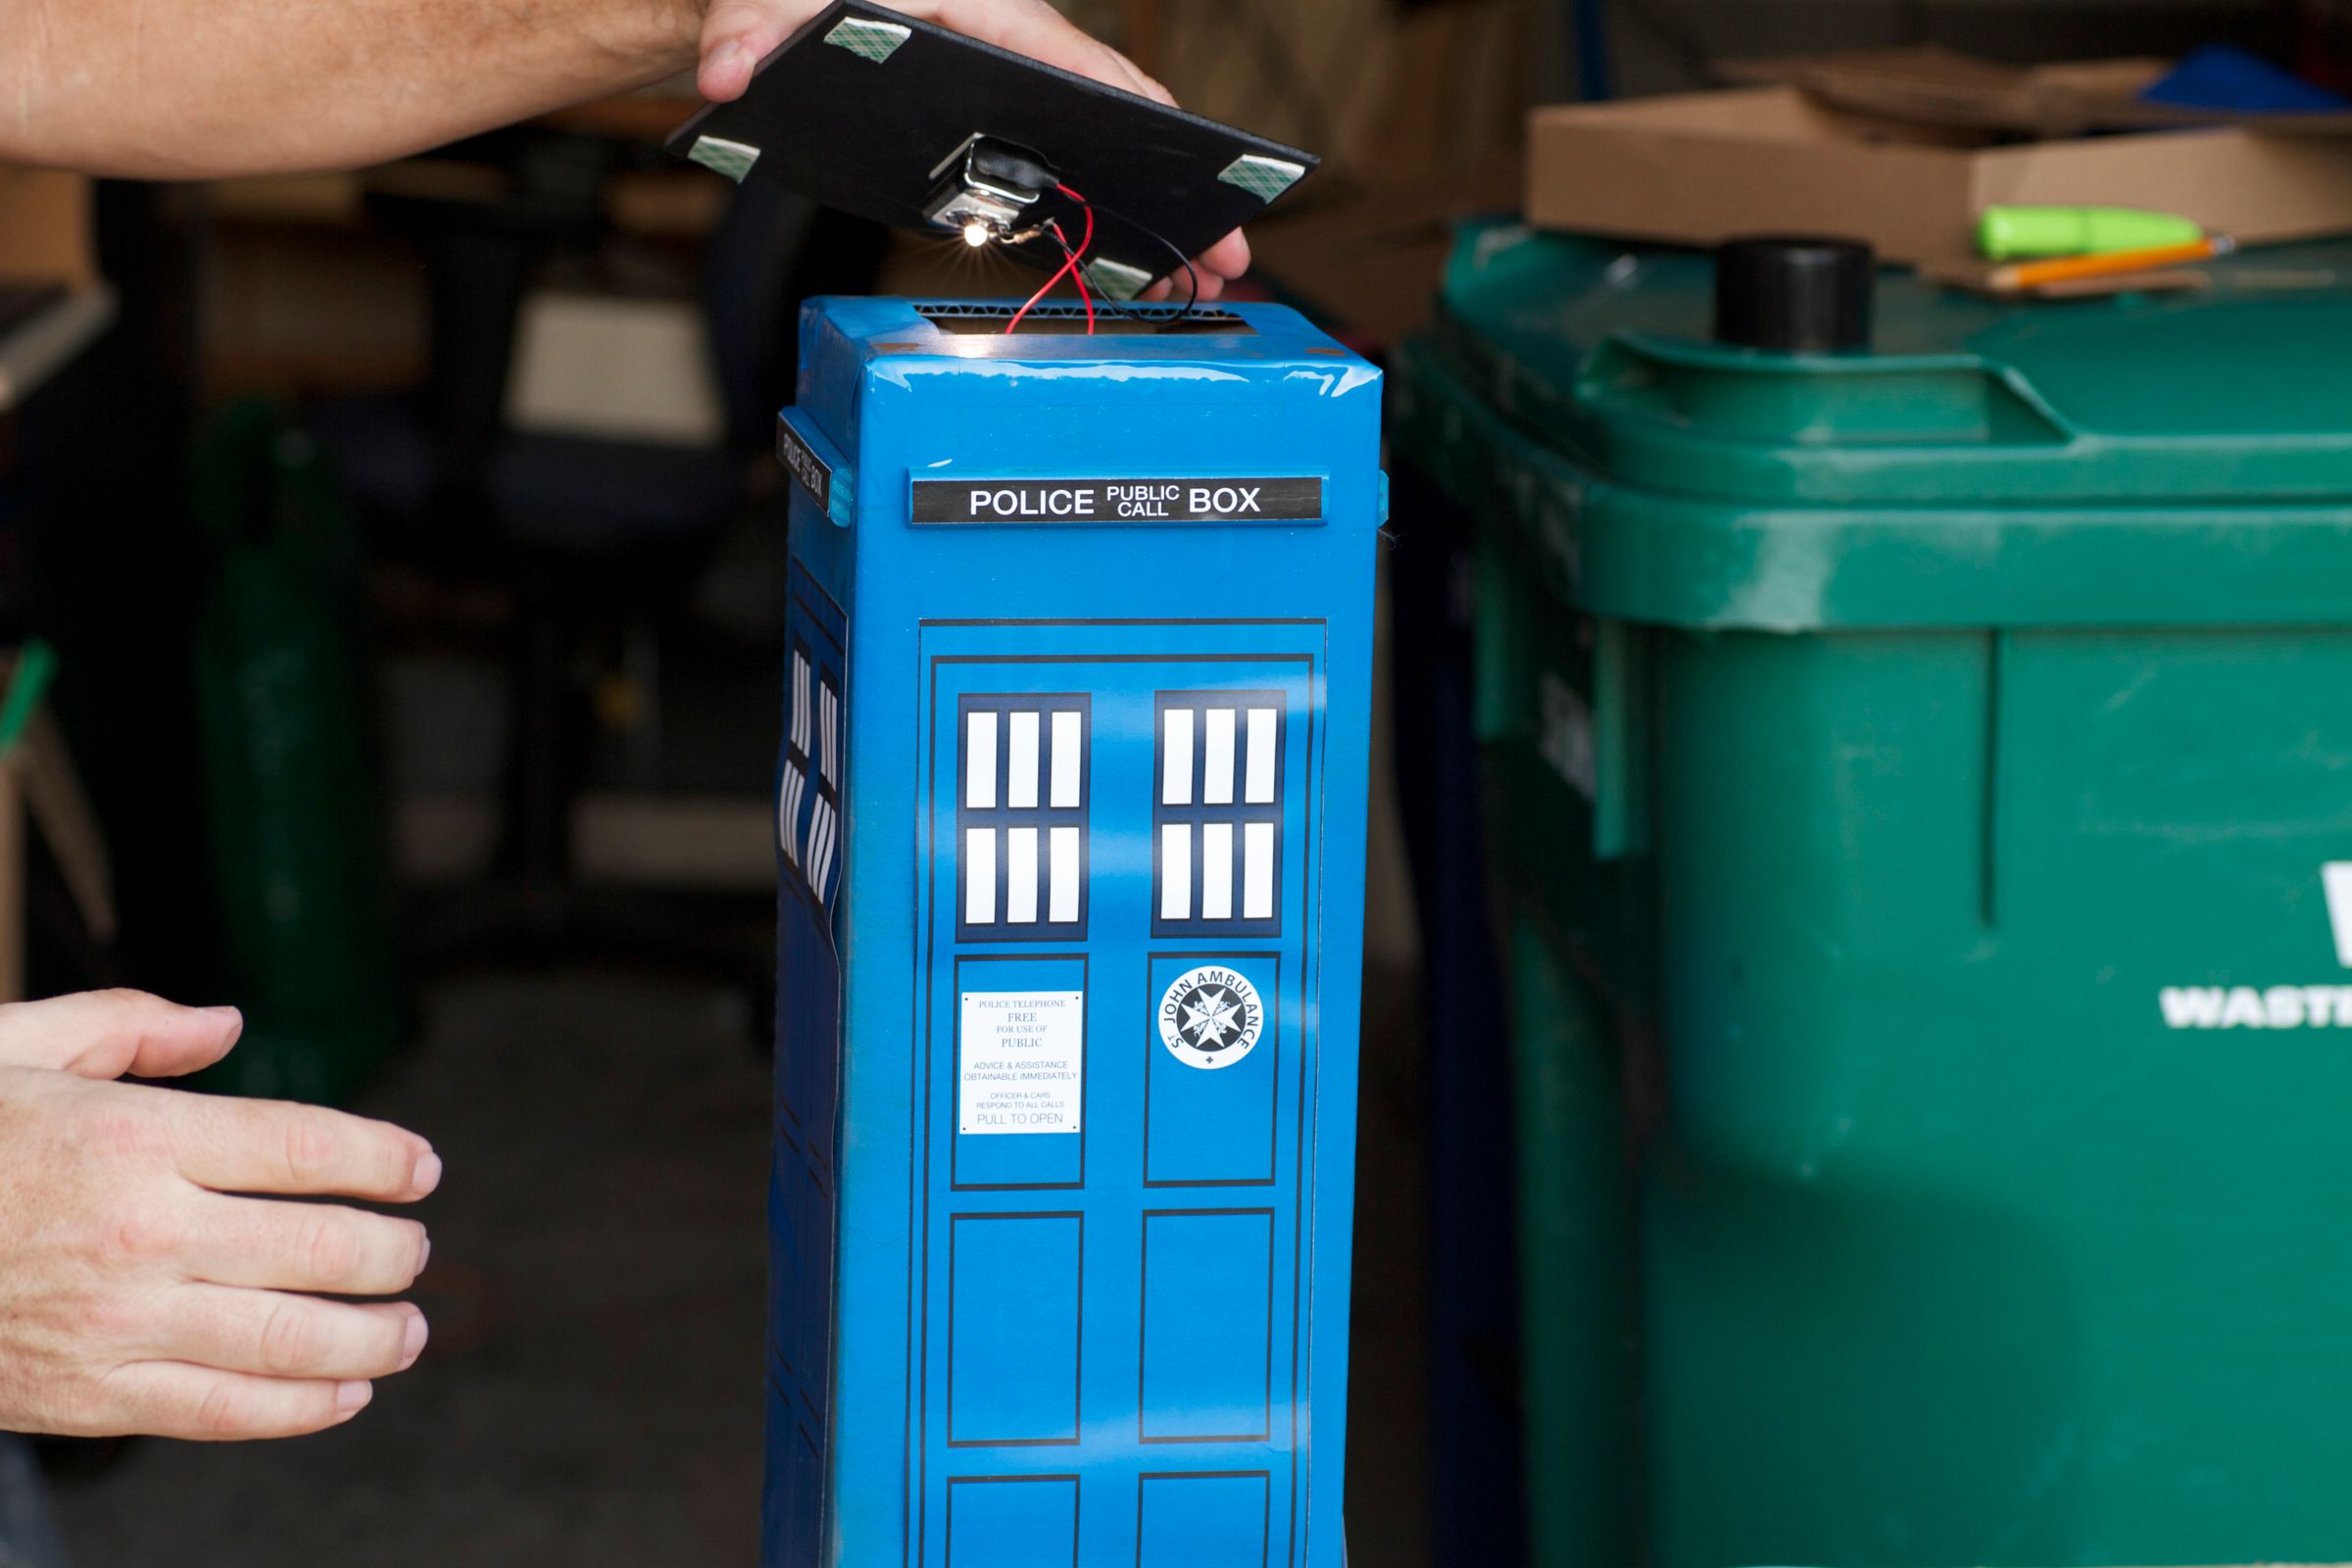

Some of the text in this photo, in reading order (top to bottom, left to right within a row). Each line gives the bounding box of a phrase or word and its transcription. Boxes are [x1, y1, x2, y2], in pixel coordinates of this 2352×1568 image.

[970, 485, 1261, 517] POLICE PUBLIC CALL BOX
[978, 999, 1067, 1009] POLICE TELEPHONE
[1163, 979, 1193, 1024] JOHN
[1197, 970, 1259, 1050] AMBULANCE
[1006, 1011, 1037, 1022] FREE
[996, 1024, 1048, 1034] FOR USE OF
[1002, 1037, 1043, 1049] PUBLIC
[973, 1060, 1069, 1070] ADVICE & ASSISTANCE
[963, 1071, 1078, 1081] OBTAINABLE IMMEDIATELY
[990, 1092, 1022, 1101] OFFICER
[977, 1112, 1063, 1125] PULL TO OPEN
